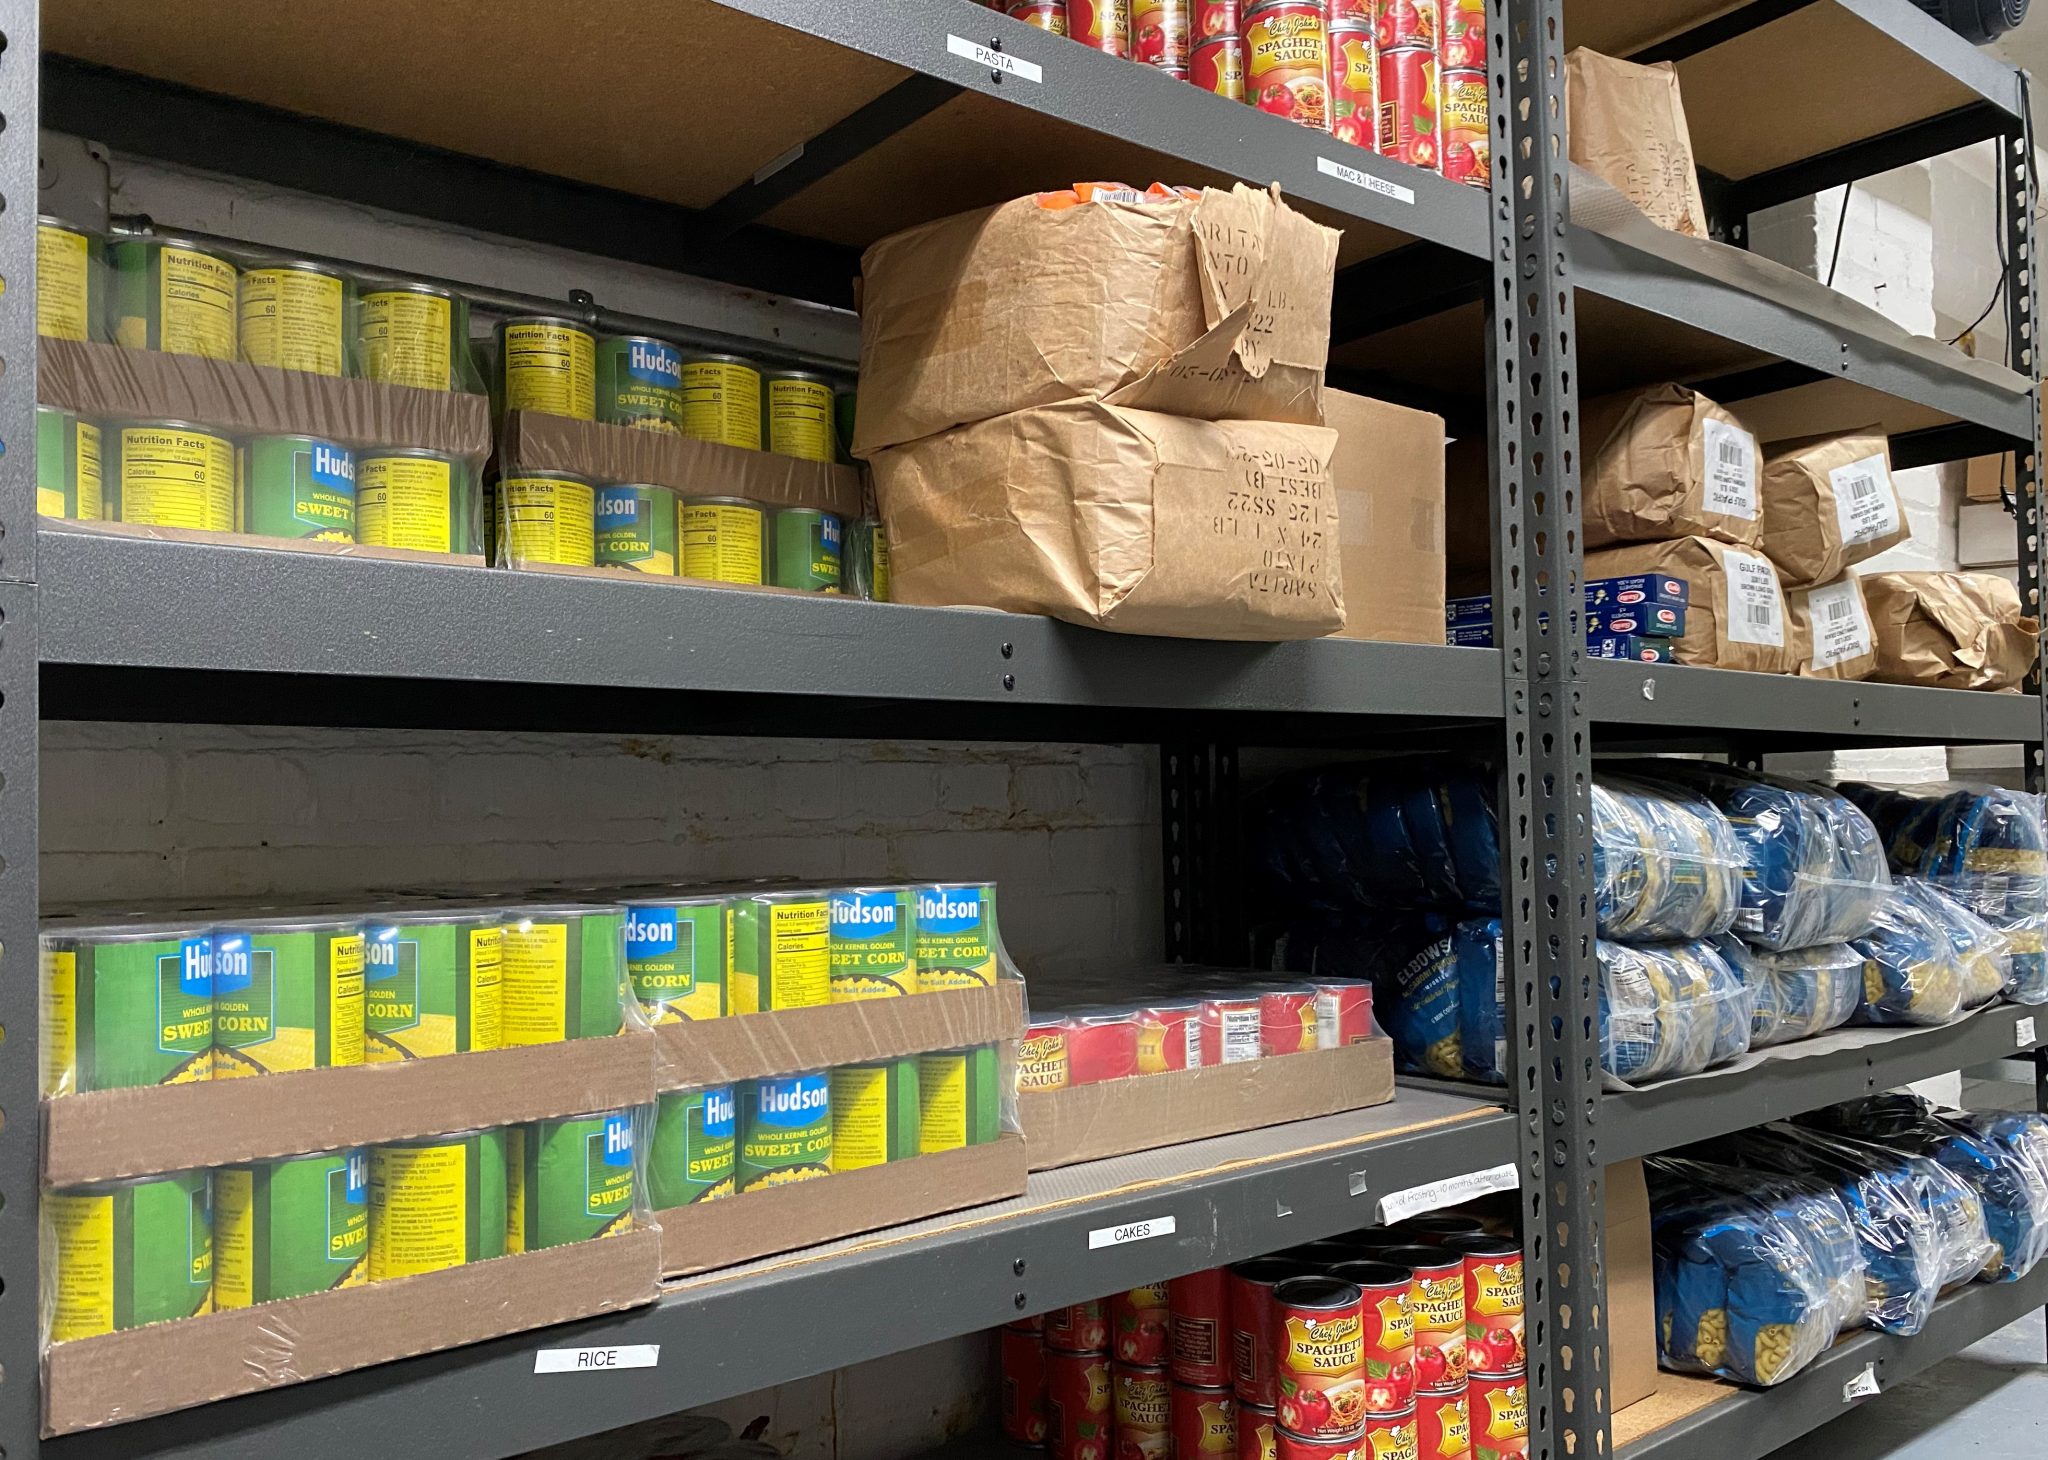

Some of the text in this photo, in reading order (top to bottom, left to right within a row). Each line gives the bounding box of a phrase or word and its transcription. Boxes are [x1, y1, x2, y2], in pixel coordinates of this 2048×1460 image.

[1270, 21, 1290, 36] Chef
[976, 48, 1014, 71] PASTA
[1275, 49, 1318, 61] SAUCE
[1337, 166, 1355, 181] MAC
[167, 255, 213, 271] Nutrition
[168, 288, 200, 299] Calories
[265, 305, 275, 314] 60
[378, 327, 388, 335] 60
[509, 331, 570, 342] Nutrition Facts
[632, 347, 681, 379] Hudson
[774, 386, 824, 396] Nutrition Facts
[618, 395, 666, 408] SWEET
[127, 436, 205, 449] Nutrition Facts
[366, 464, 386, 473] Facts
[194, 471, 205, 480] 60
[530, 485, 554, 493] Facts
[377, 493, 386, 501] 60
[297, 502, 349, 520] SWEET
[1228, 492, 1318, 524] 125 SS22
[610, 542, 649, 552] CORN
[776, 911, 814, 920] Nutrition
[830, 897, 894, 924] Hudson
[956, 936, 978, 944] GOLDEN
[867, 952, 905, 963] CORN
[953, 945, 988, 957] CORN
[645, 964, 674, 972] GOLDEN
[1396, 938, 1451, 986] ELBOWS
[642, 974, 690, 987] CORN
[369, 990, 395, 999] GOLDEN
[221, 1003, 248, 1011] GOLDEN
[368, 1004, 413, 1017] CORN
[164, 1016, 268, 1041] SWEE CORN
[1018, 1044, 1039, 1059] Chef
[1022, 1072, 1062, 1087] SAUCE
[761, 1082, 827, 1112] Hudson
[758, 1132, 783, 1141] WHOLE
[784, 1130, 807, 1139] KERNEL
[744, 1142, 802, 1156] SWEET
[690, 1152, 733, 1174] SWEET
[1115, 1224, 1150, 1241] CAKES
[1426, 1287, 1445, 1298] Chef
[1430, 1309, 1463, 1324] SAUCE
[1310, 1317, 1357, 1340] Chef John's
[578, 1350, 618, 1367] RICE
[1314, 1352, 1356, 1368] SAUCE
